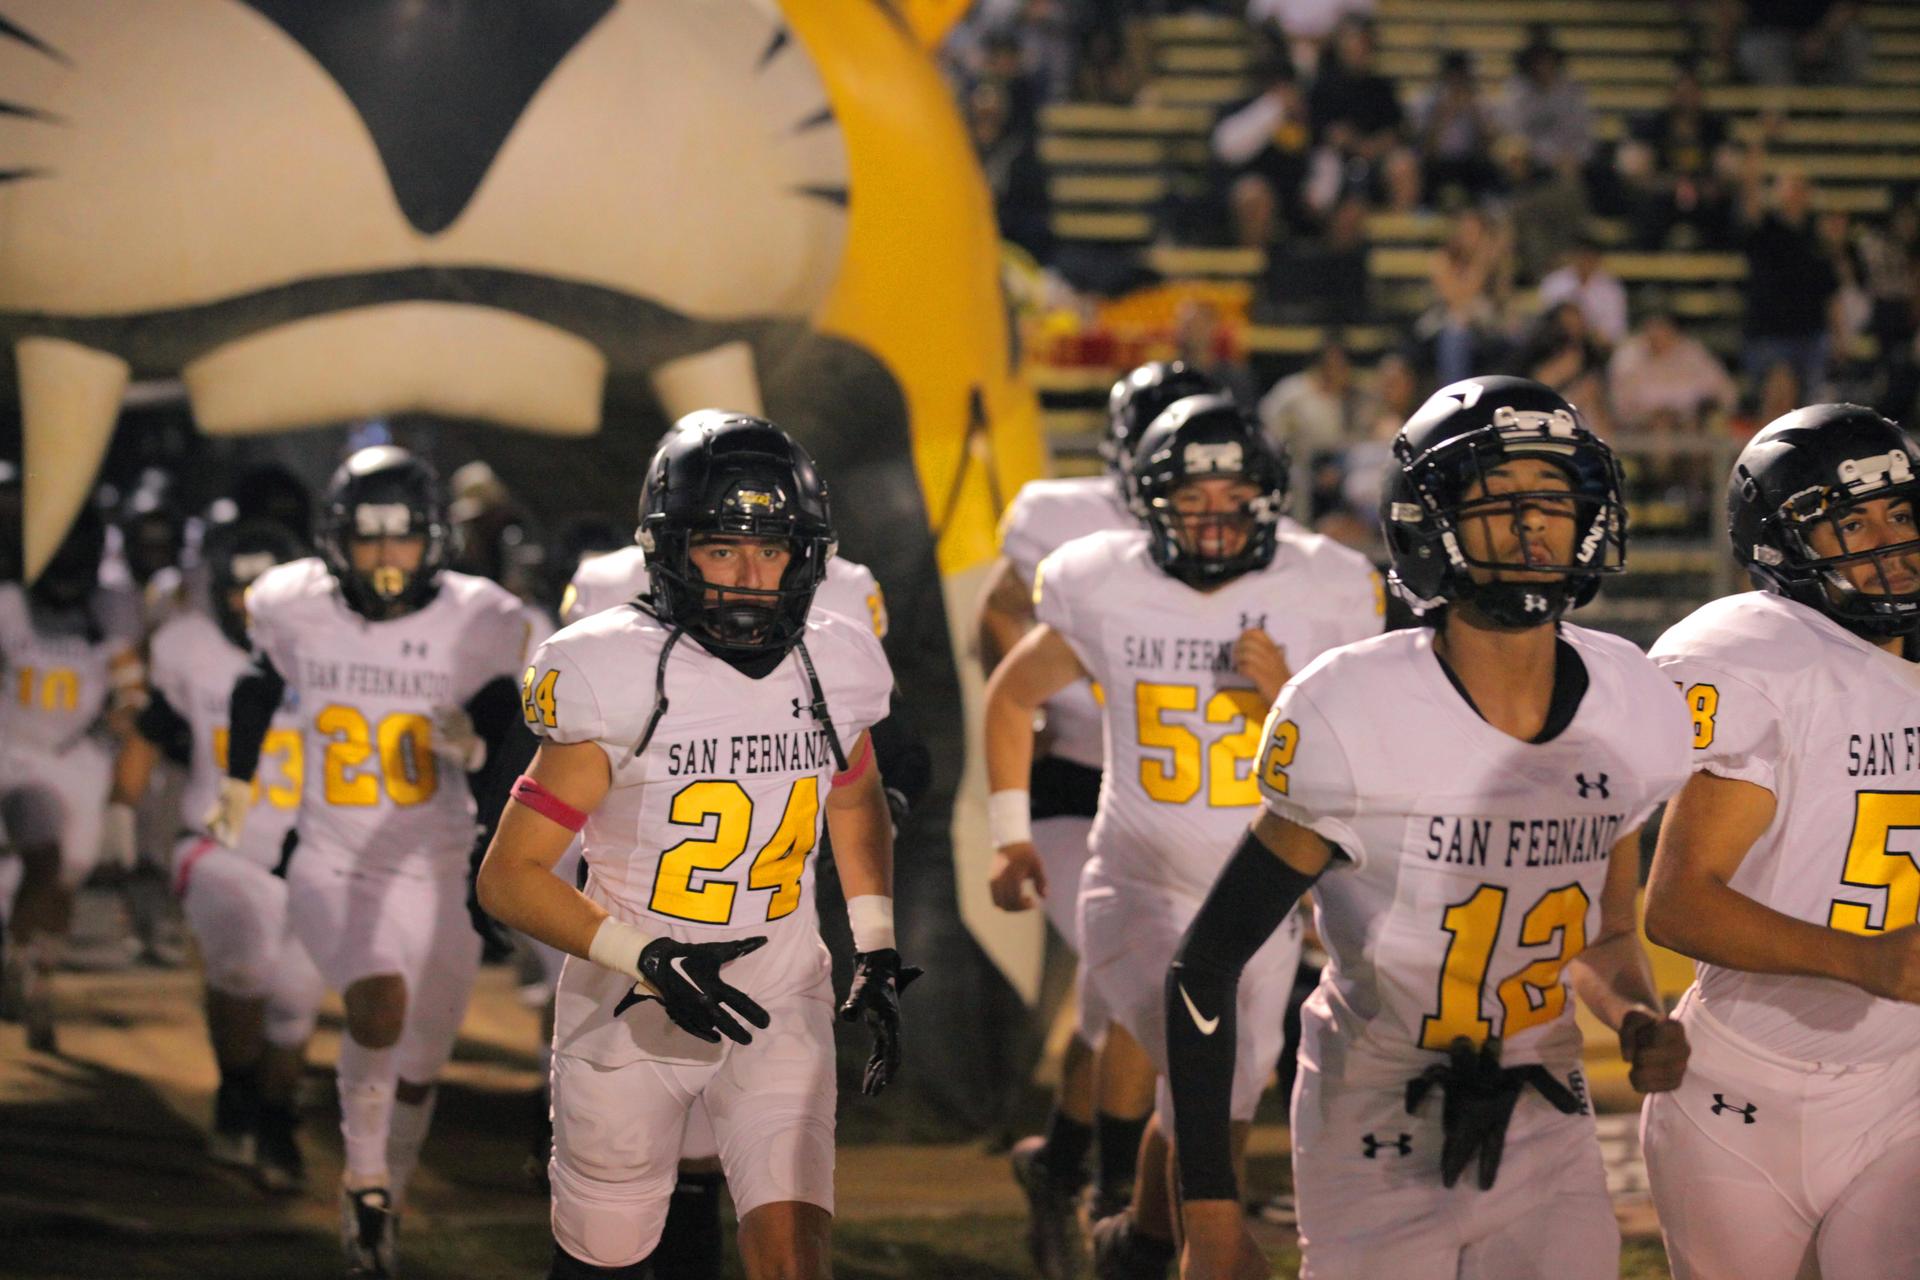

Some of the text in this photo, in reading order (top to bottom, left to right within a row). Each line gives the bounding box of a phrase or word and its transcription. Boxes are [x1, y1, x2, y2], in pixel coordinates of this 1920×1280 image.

[1124, 635, 1165, 668] SAN
[522, 665, 561, 728] 24
[1673, 680, 1720, 750] 8
[315, 702, 438, 808] 20
[668, 729, 831, 776] SAN FERNAND
[1135, 679, 1270, 808] 52
[1847, 733, 1895, 777] SAN
[648, 775, 821, 926] 24
[1426, 813, 1625, 868] SAN FERNAND
[1416, 881, 1591, 1054] 12
